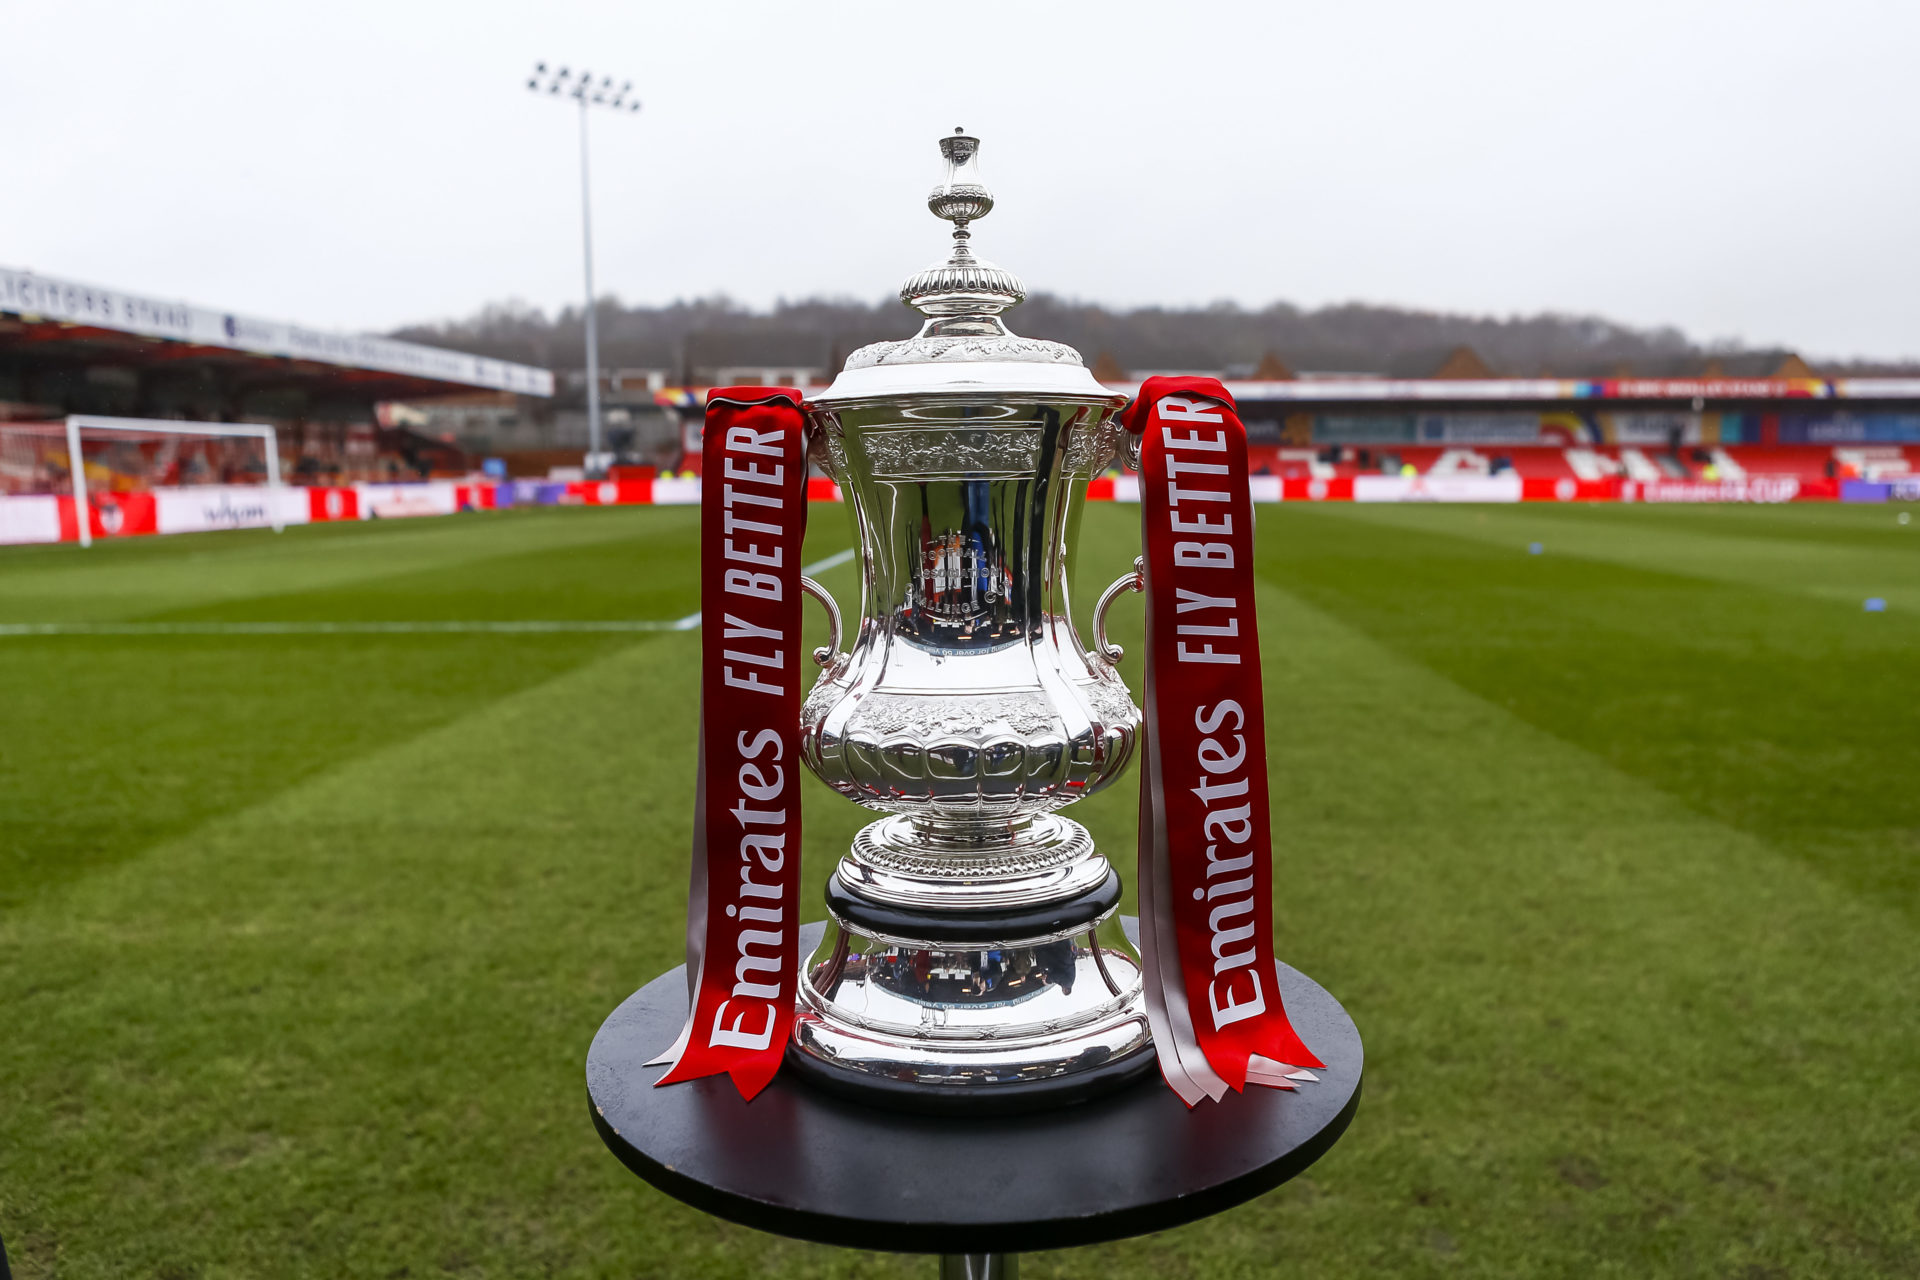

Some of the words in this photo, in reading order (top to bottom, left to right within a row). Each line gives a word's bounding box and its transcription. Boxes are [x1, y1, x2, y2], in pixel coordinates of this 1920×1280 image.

[723, 426, 785, 602] BETTER
[939, 534, 966, 546] THE
[1156, 396, 1235, 569] BETTER
[920, 547, 988, 564] FOOTBALL
[723, 612, 784, 697] FLY
[1175, 587, 1241, 664] FLY
[709, 728, 786, 1051] Emirates
[1191, 699, 1267, 1032] Emirates
